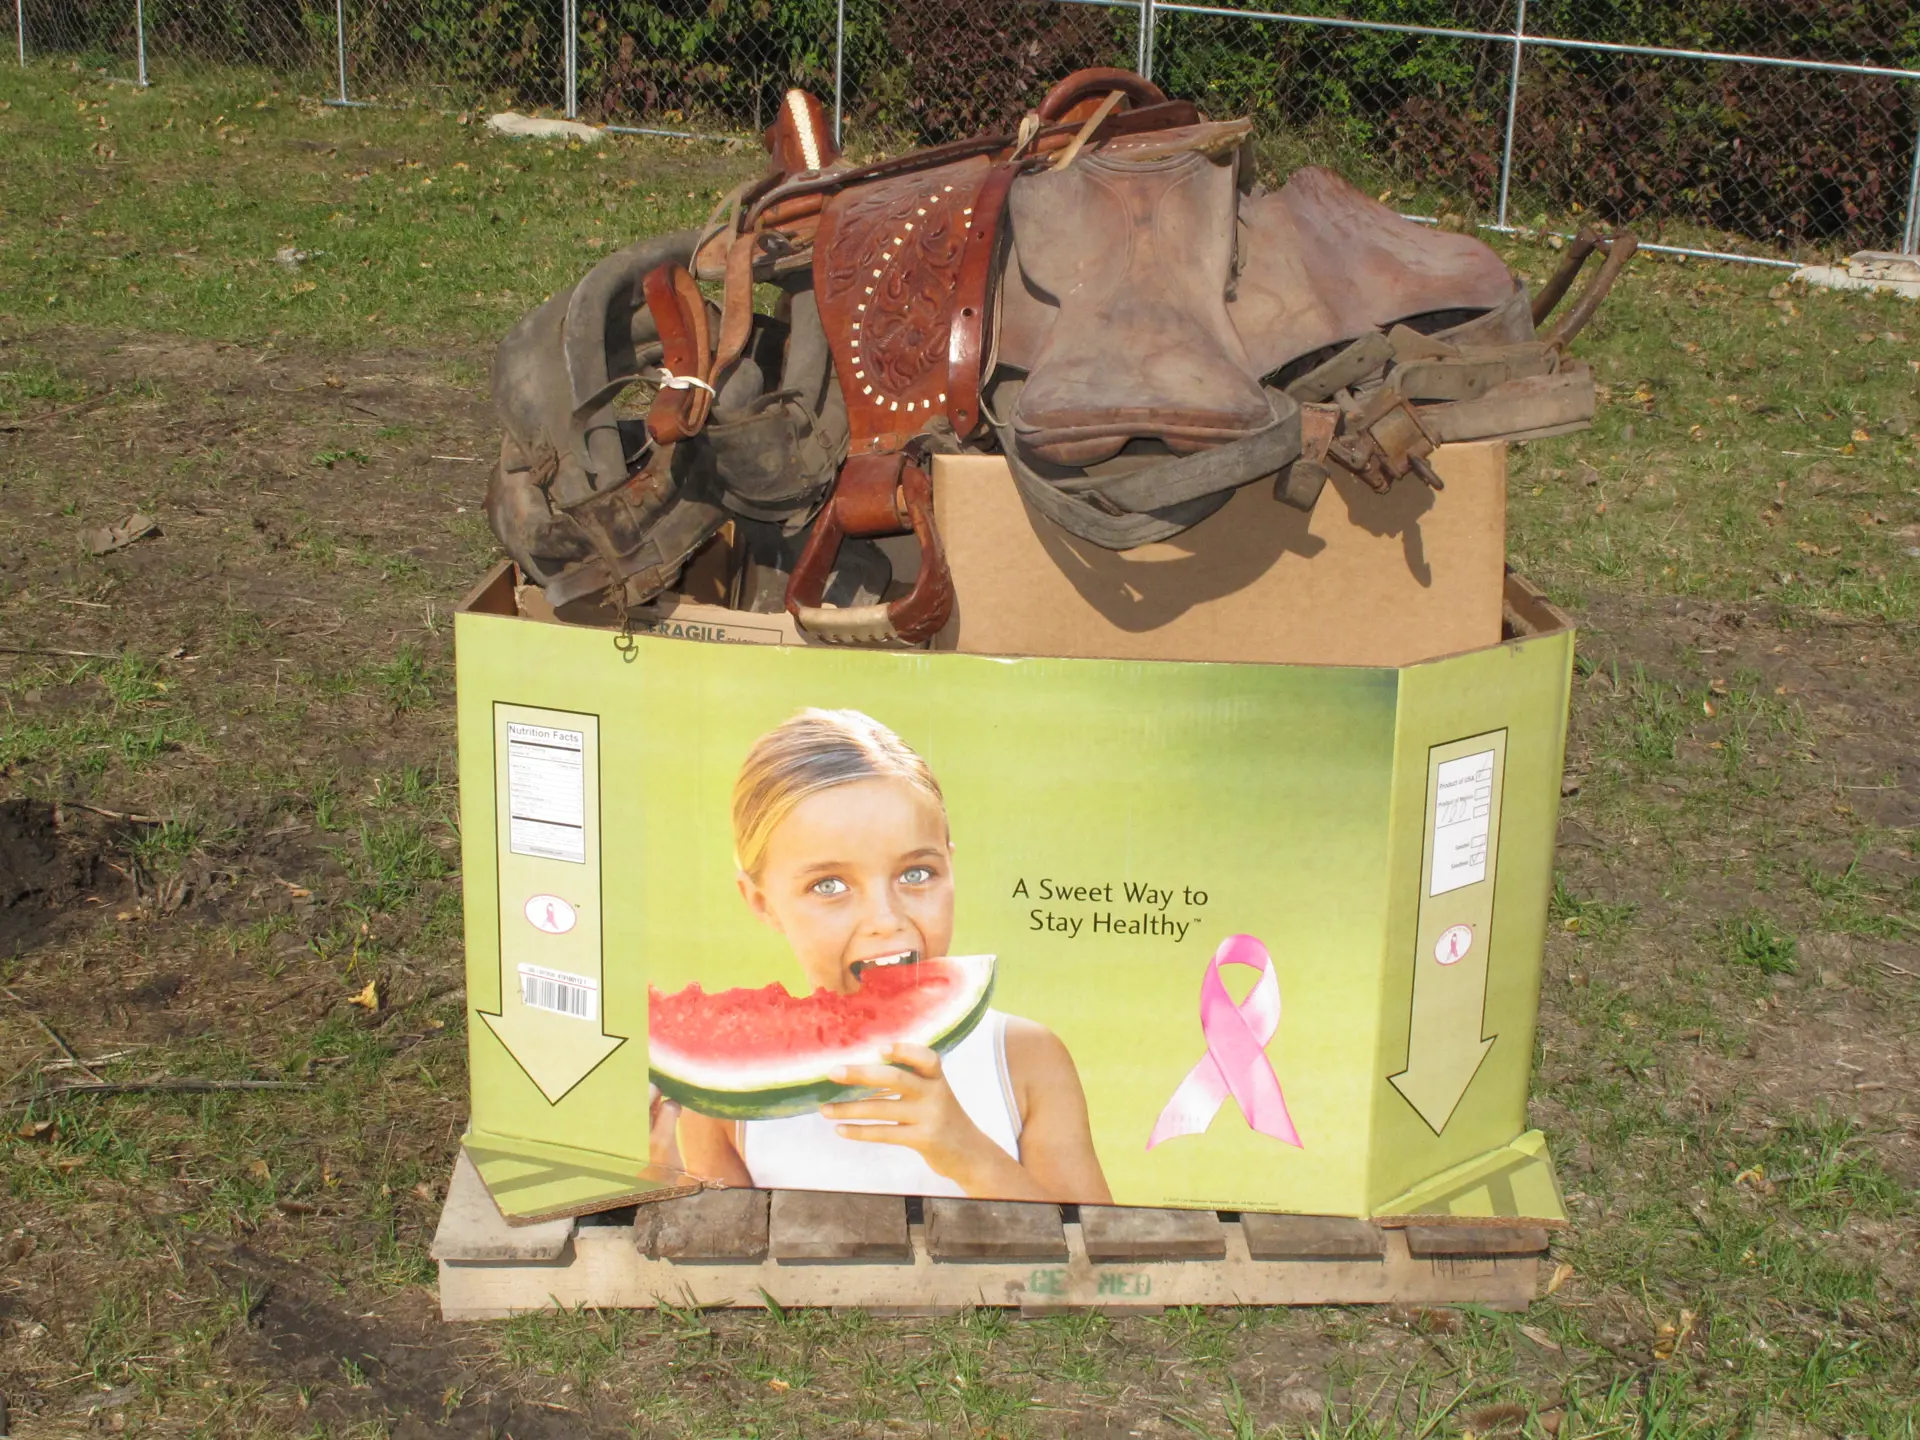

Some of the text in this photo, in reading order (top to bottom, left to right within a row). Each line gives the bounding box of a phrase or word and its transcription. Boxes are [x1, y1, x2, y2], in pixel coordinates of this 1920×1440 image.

[647, 622, 726, 641] FRAGILE
[509, 725, 579, 743] Nutrition Facts
[1439, 780, 1458, 790] Product
[1011, 877, 1209, 911] A Sweet Way to
[1029, 909, 1083, 939] Stay
